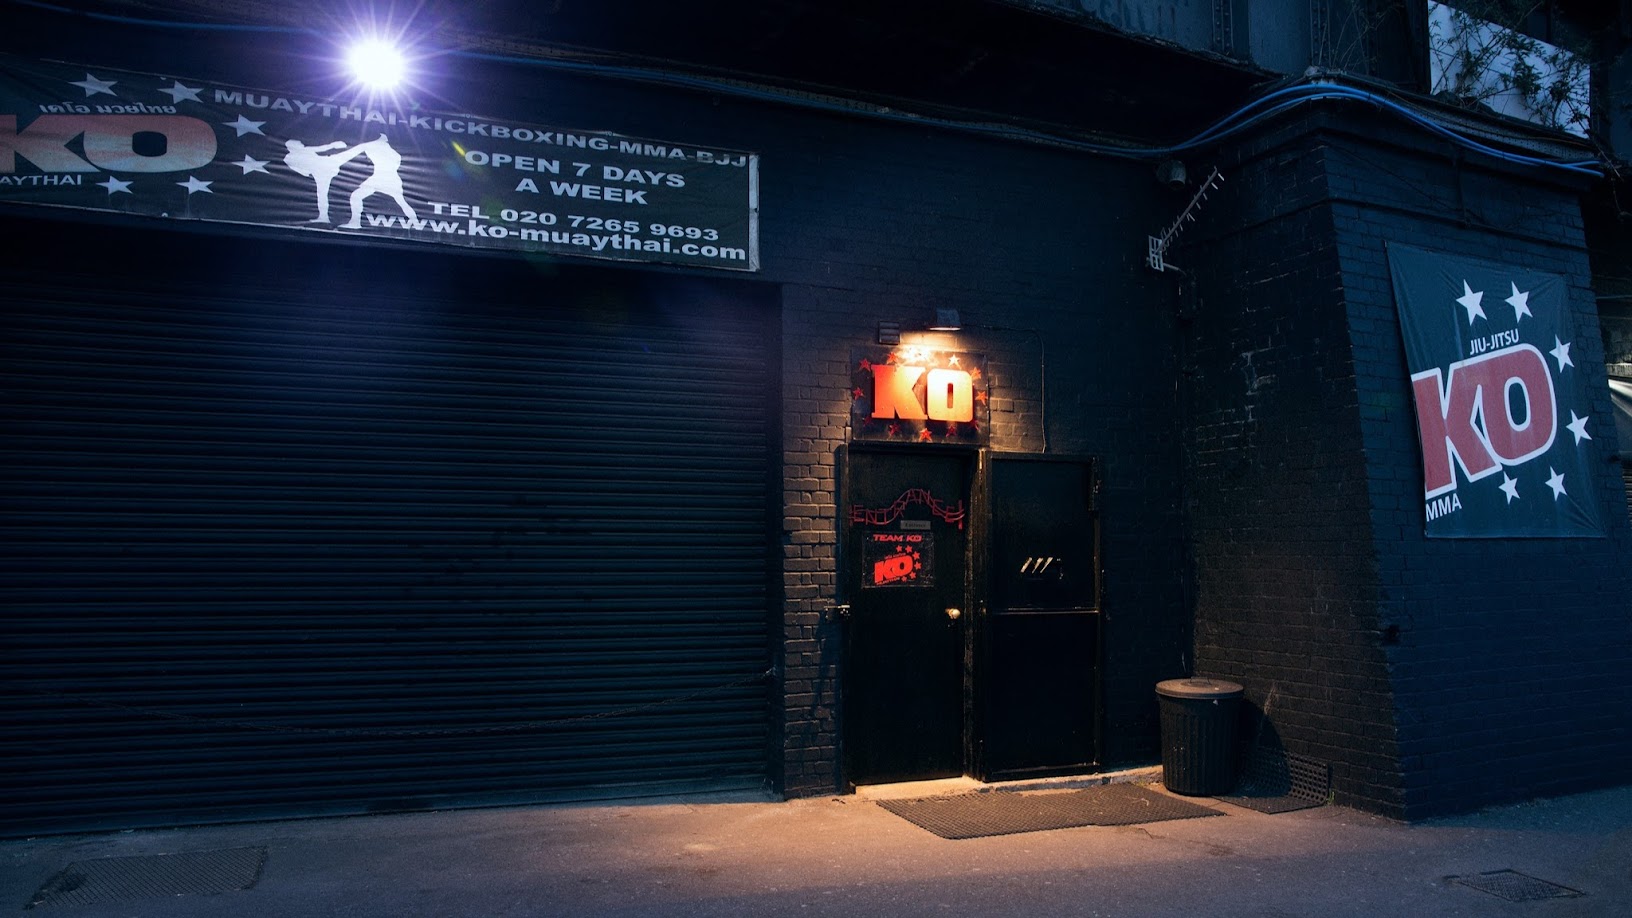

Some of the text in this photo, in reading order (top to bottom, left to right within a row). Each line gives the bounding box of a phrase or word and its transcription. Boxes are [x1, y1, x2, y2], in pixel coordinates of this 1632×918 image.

[465, 150, 686, 188] OPEN 7 DAYS
[515, 178, 649, 205] A WEEK
[366, 213, 746, 261] www.ko-muaythai.com
[428, 202, 719, 241] TEL 020 7265 9693
[1469, 328, 1520, 355] JIU-JITSU
[872, 366, 973, 422] KO
[1411, 343, 1557, 499] KO
[1425, 493, 1462, 522] MMA
[873, 533, 922, 542] TEAM KO
[874, 555, 914, 584] KO
